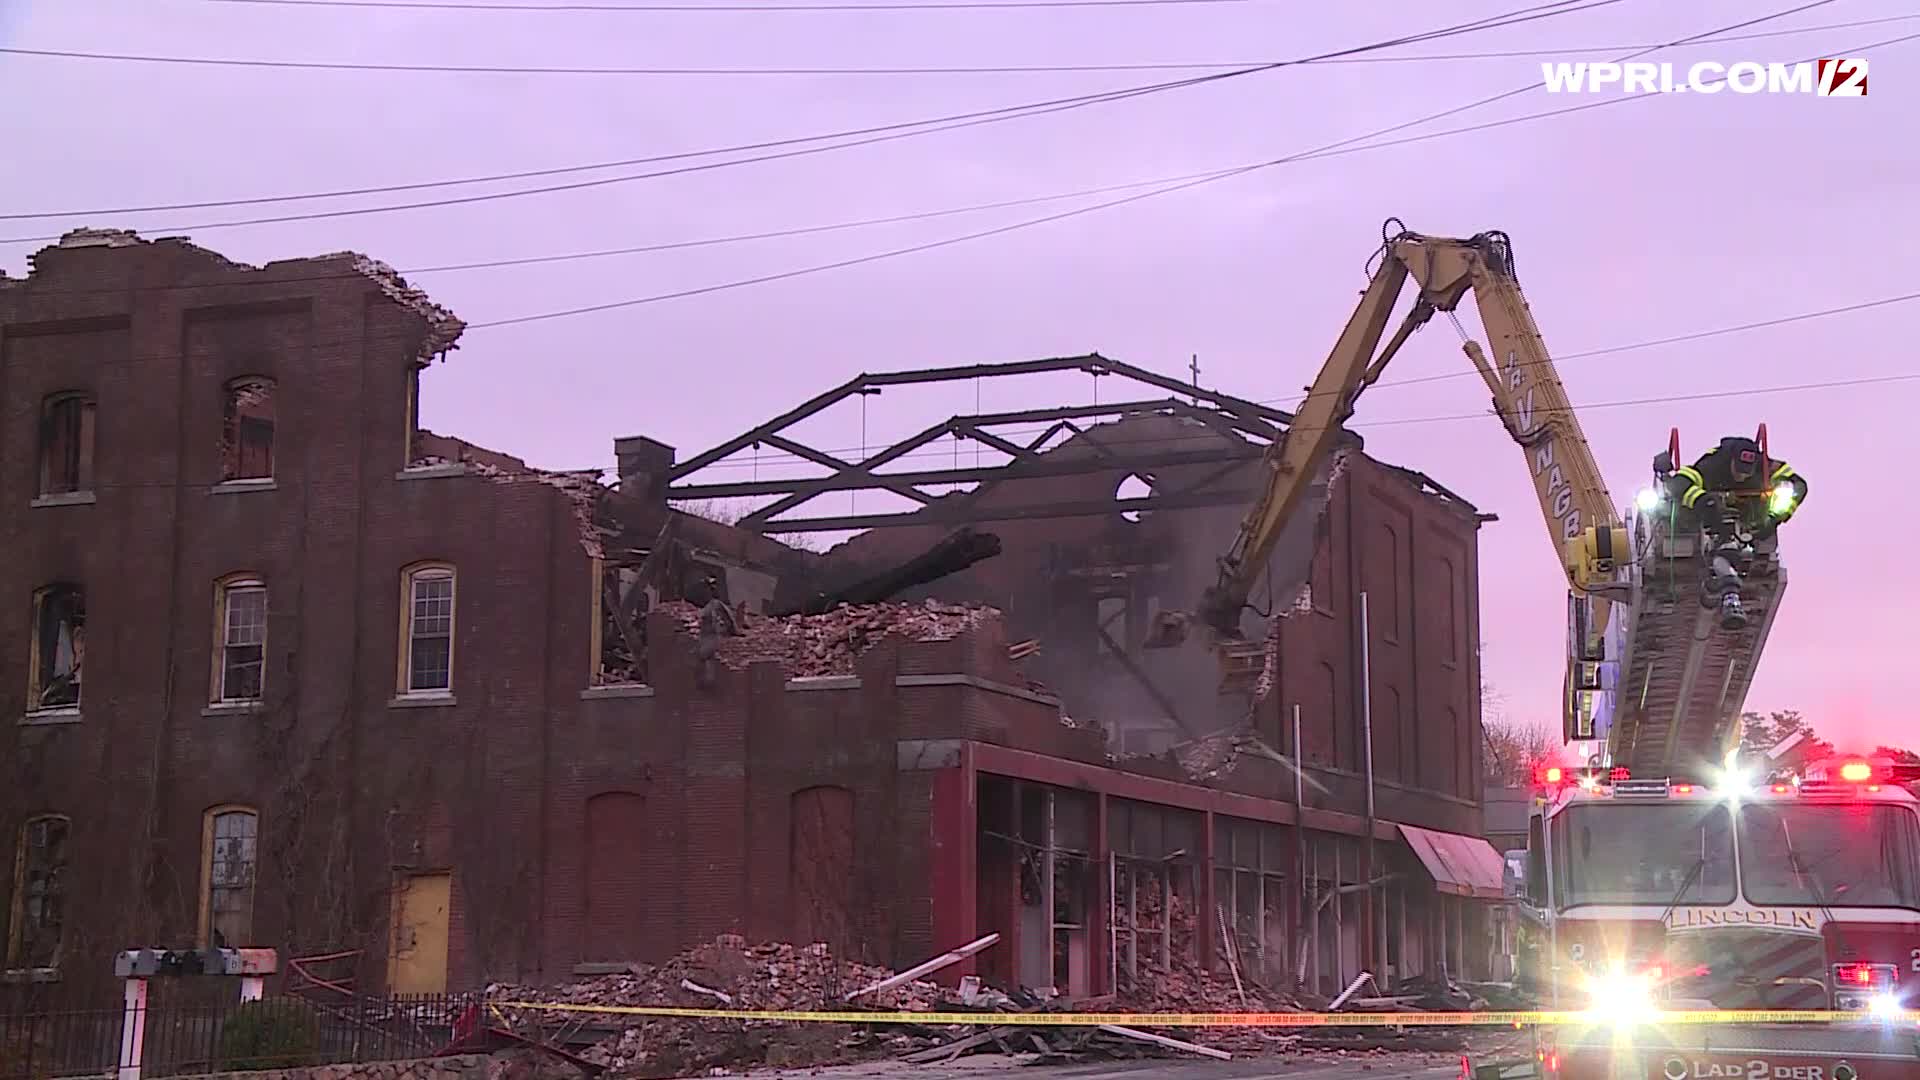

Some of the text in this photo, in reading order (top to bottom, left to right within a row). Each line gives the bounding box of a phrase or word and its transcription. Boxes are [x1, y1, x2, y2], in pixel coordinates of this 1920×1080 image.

[1670, 908, 1817, 930] LINCOLN
[1693, 1059, 1823, 1080] LAD 2 DER
